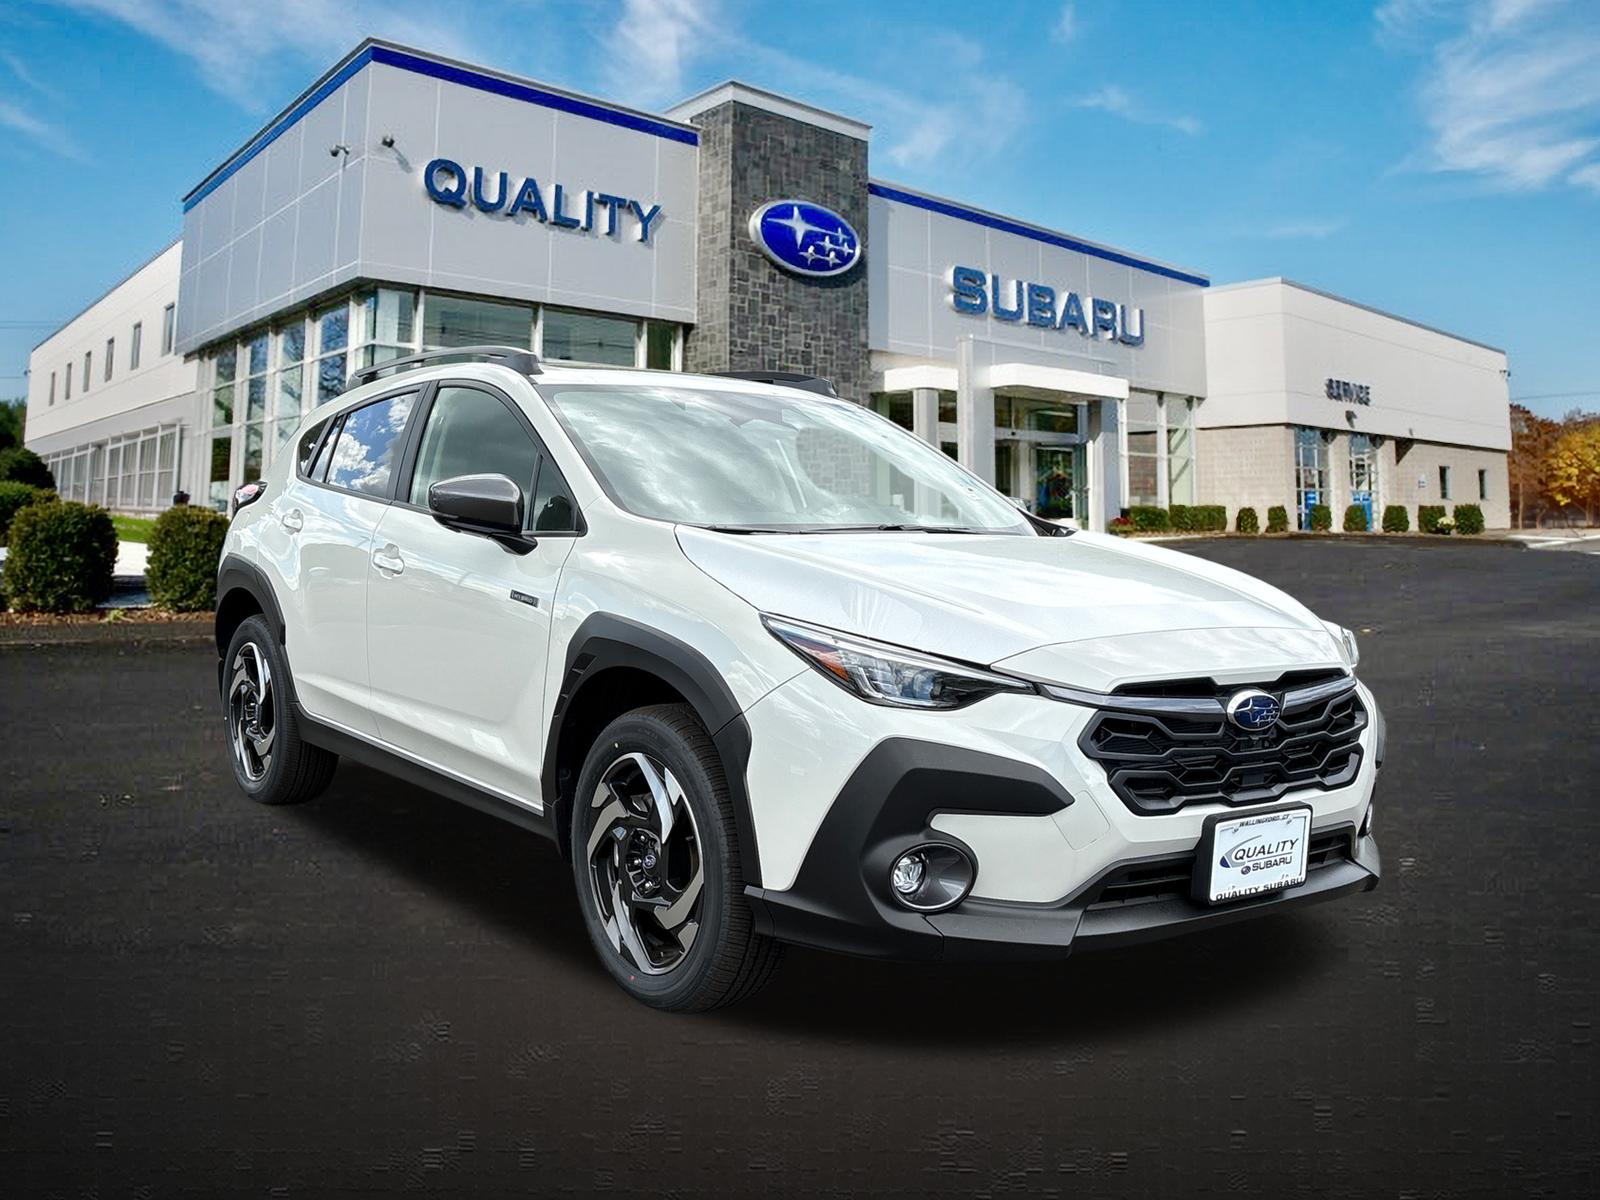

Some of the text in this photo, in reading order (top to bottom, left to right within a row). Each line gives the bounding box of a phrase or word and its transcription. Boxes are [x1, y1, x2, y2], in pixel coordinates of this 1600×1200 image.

[424, 158, 661, 243] QUALITY
[950, 265, 1145, 346] SUBARU
[1326, 378, 1371, 407] SERVICE
[1234, 838, 1299, 861] QUALITY
[1252, 856, 1293, 871] SUBARU
[1216, 876, 1304, 901] QUALITY SUBARU
